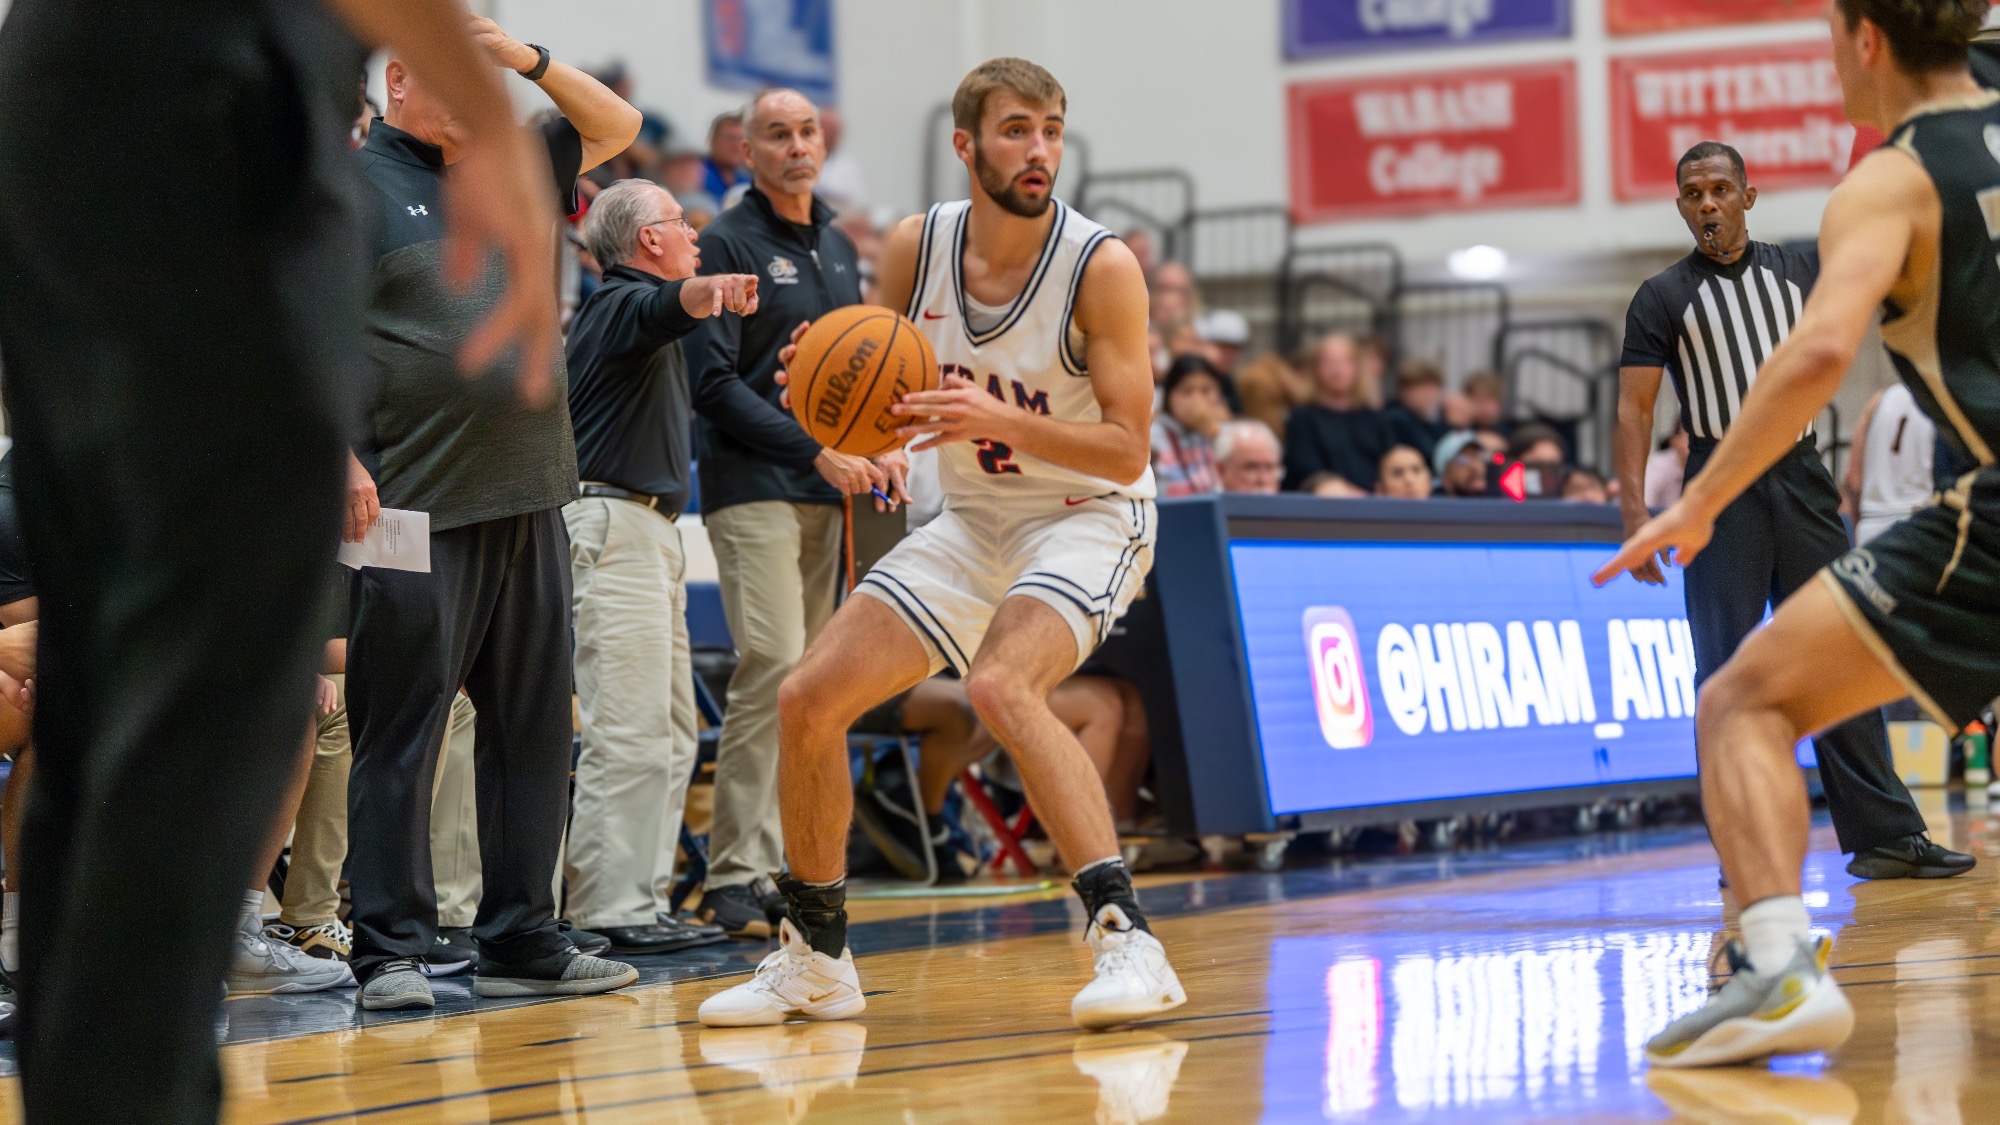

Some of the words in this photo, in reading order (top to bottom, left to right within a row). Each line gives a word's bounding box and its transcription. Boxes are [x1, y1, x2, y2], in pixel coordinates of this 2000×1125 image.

[1355, 82, 1512, 137] WABASH
[1635, 58, 1844, 118] WITTENBE
[1369, 142, 1501, 201] College
[815, 338, 878, 428] Wilson
[970, 437, 1023, 475] 2
